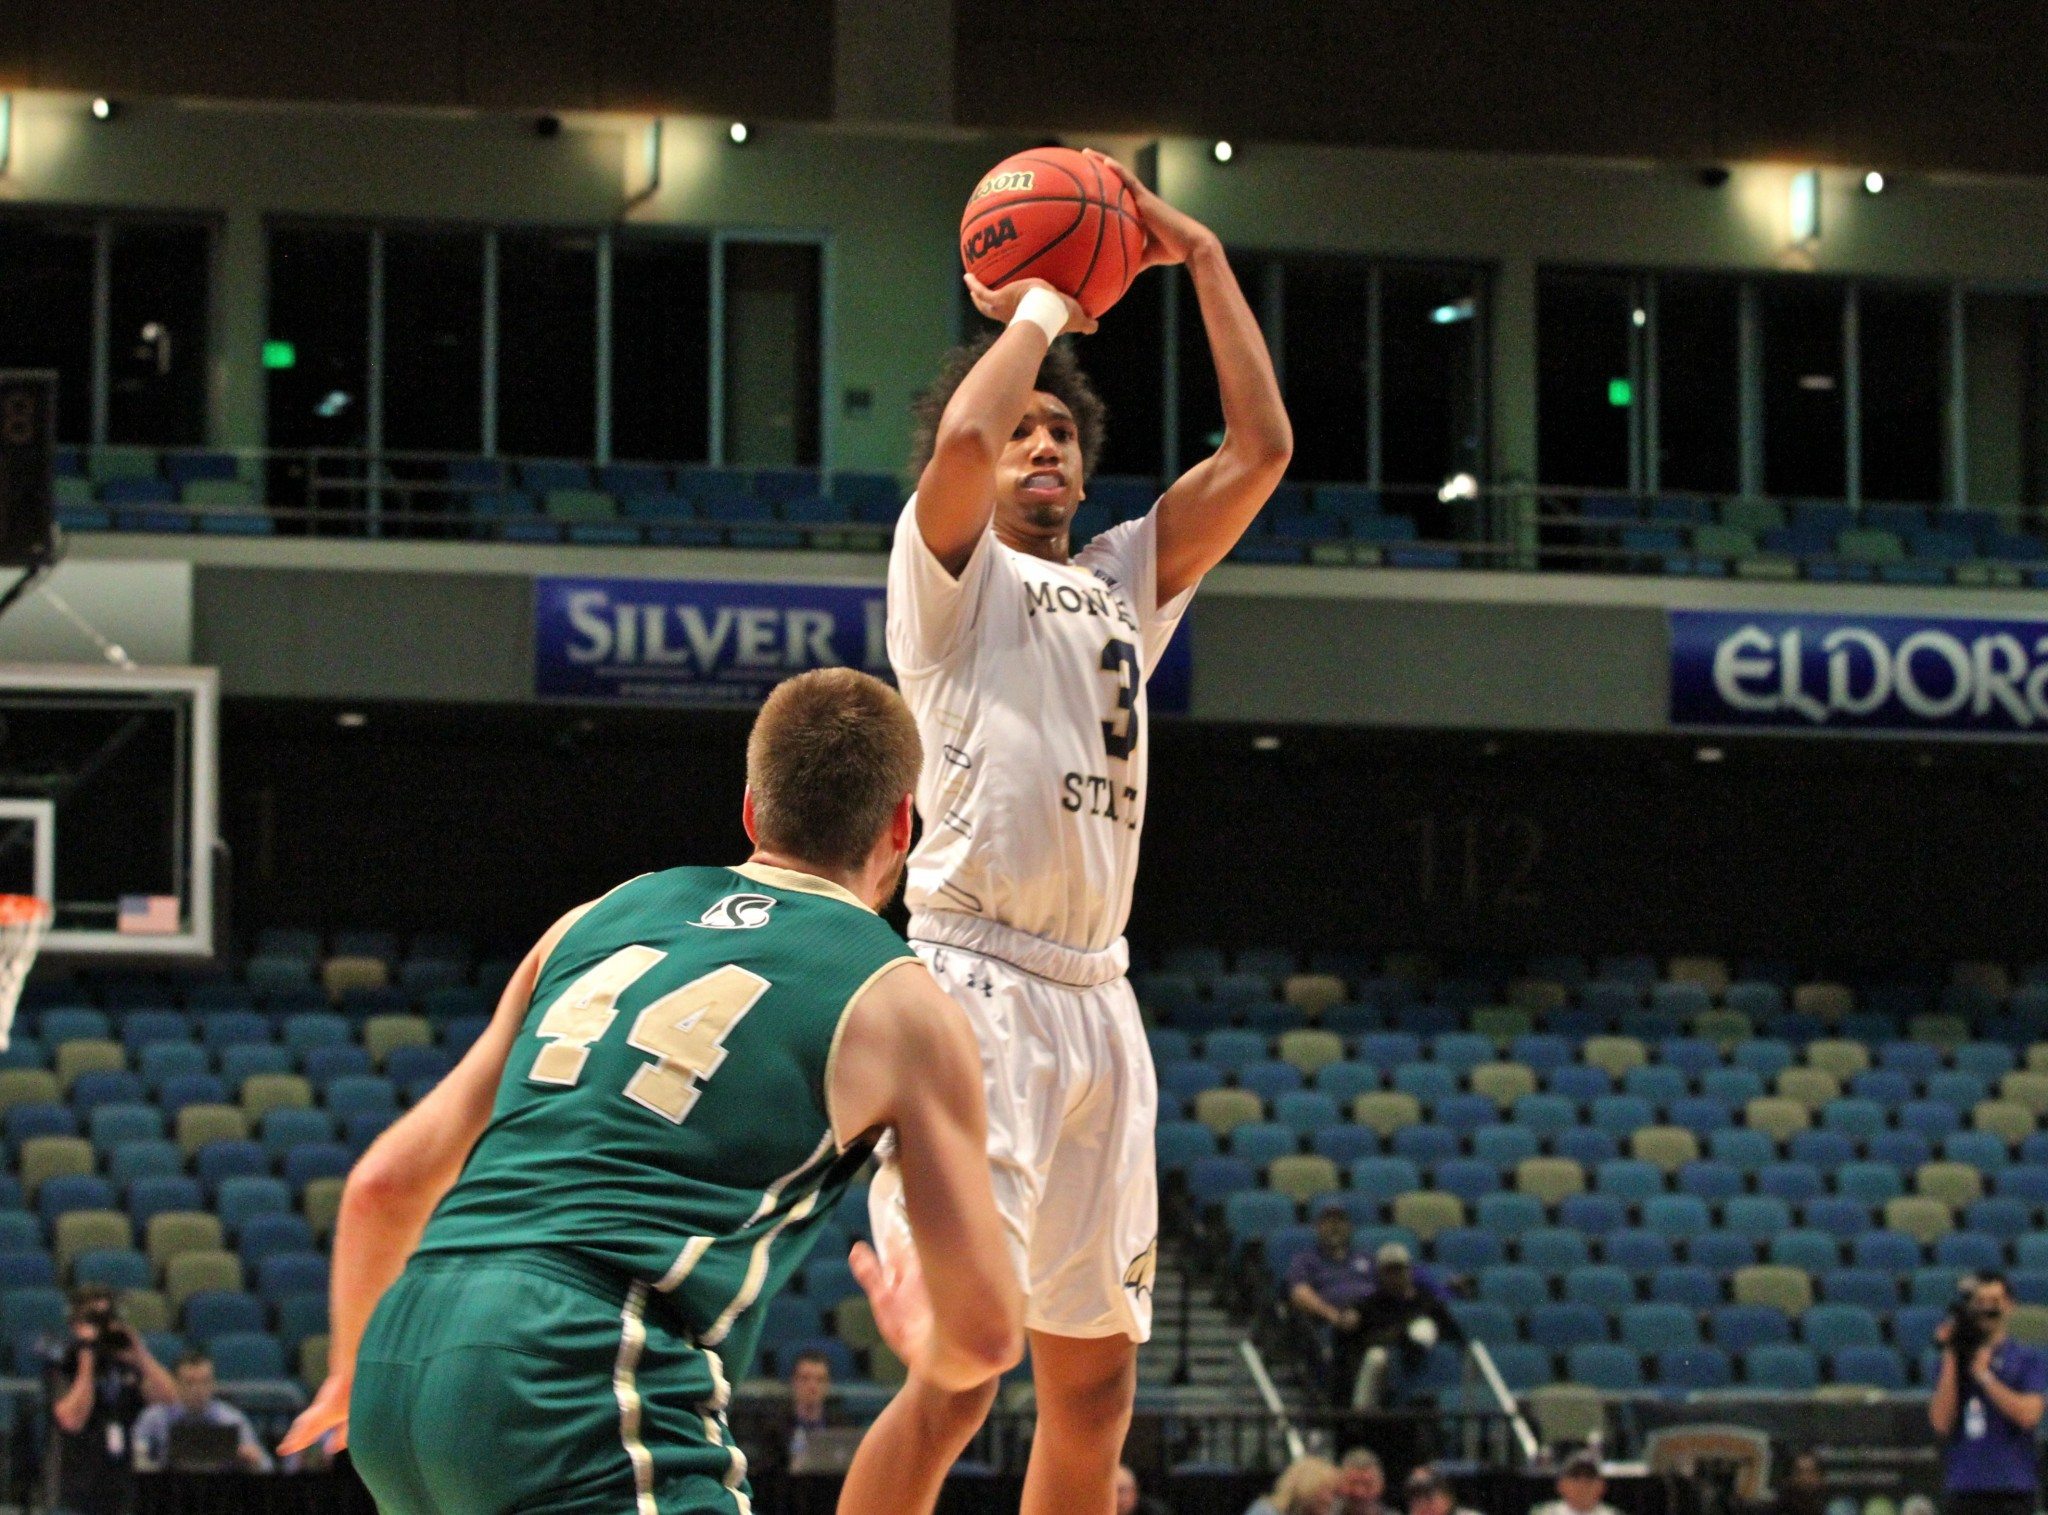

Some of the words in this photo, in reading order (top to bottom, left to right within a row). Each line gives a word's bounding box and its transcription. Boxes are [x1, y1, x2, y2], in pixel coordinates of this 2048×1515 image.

[567, 589, 839, 671] SILVER
[1101, 637, 1140, 761] 3
[528, 944, 773, 1125] 44
